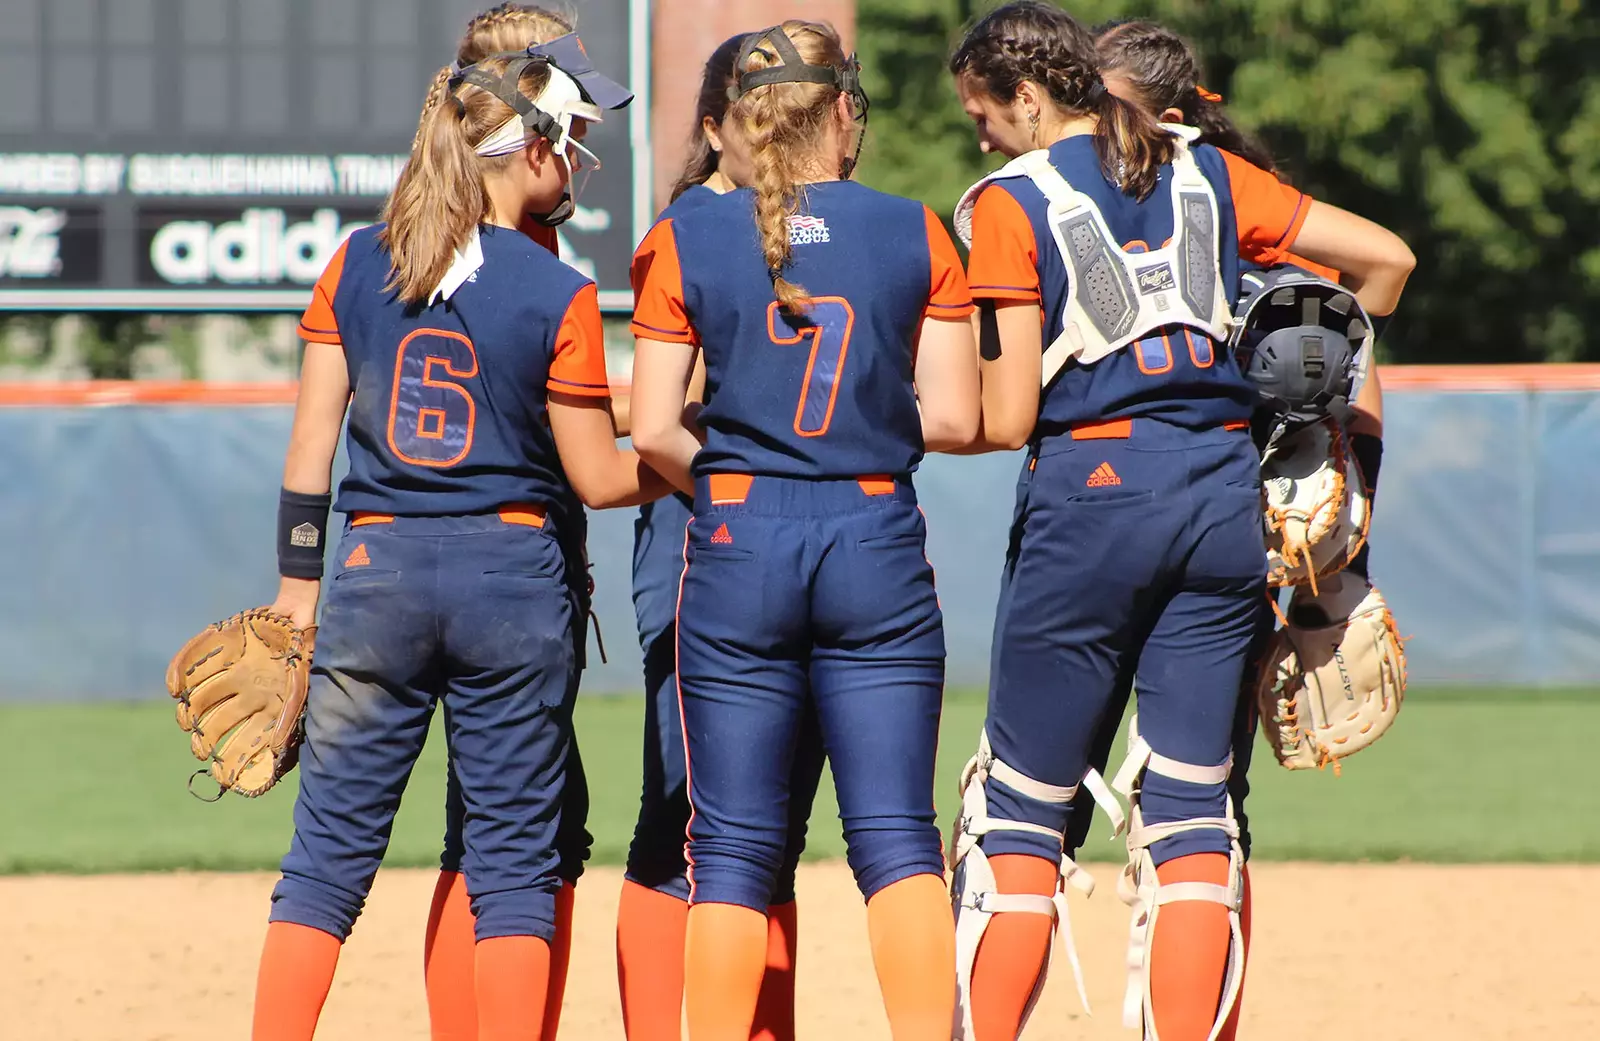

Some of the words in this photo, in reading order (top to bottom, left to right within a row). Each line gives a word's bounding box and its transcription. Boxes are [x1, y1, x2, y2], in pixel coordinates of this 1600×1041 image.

[129, 153, 336, 194] SUSQUEHANNA
[151, 208, 376, 284] adid
[386, 327, 479, 469] 6
[766, 295, 855, 438] 7
[1086, 476, 1122, 488] adidas
[1331, 642, 1354, 701] EASTON
